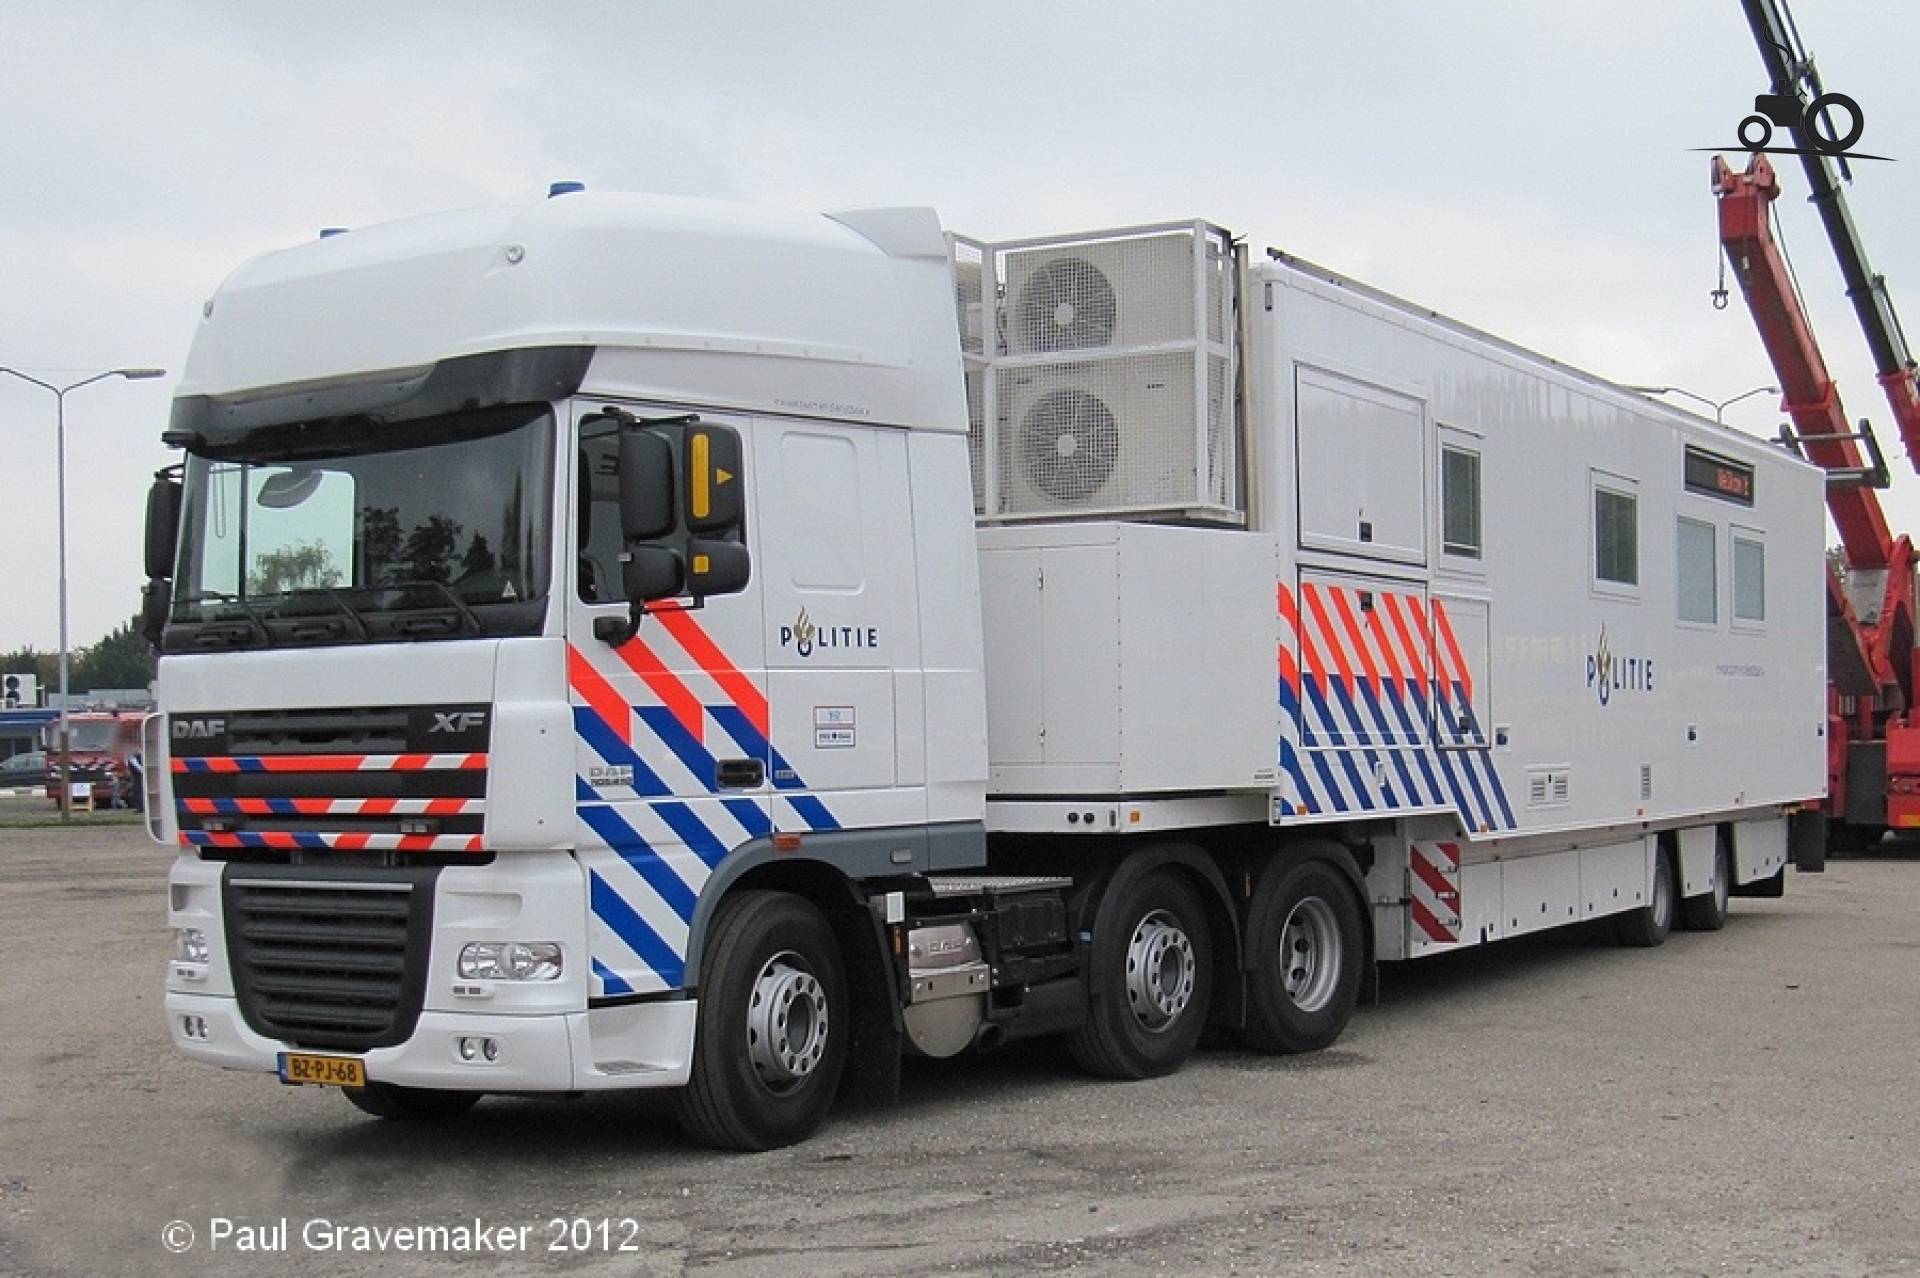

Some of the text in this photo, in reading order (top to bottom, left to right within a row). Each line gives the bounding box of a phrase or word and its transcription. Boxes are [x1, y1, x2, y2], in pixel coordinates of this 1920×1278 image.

[172, 719, 225, 739] DAF
[429, 712, 485, 733] XF
[291, 1058, 357, 1082] BZ-PJ-68
